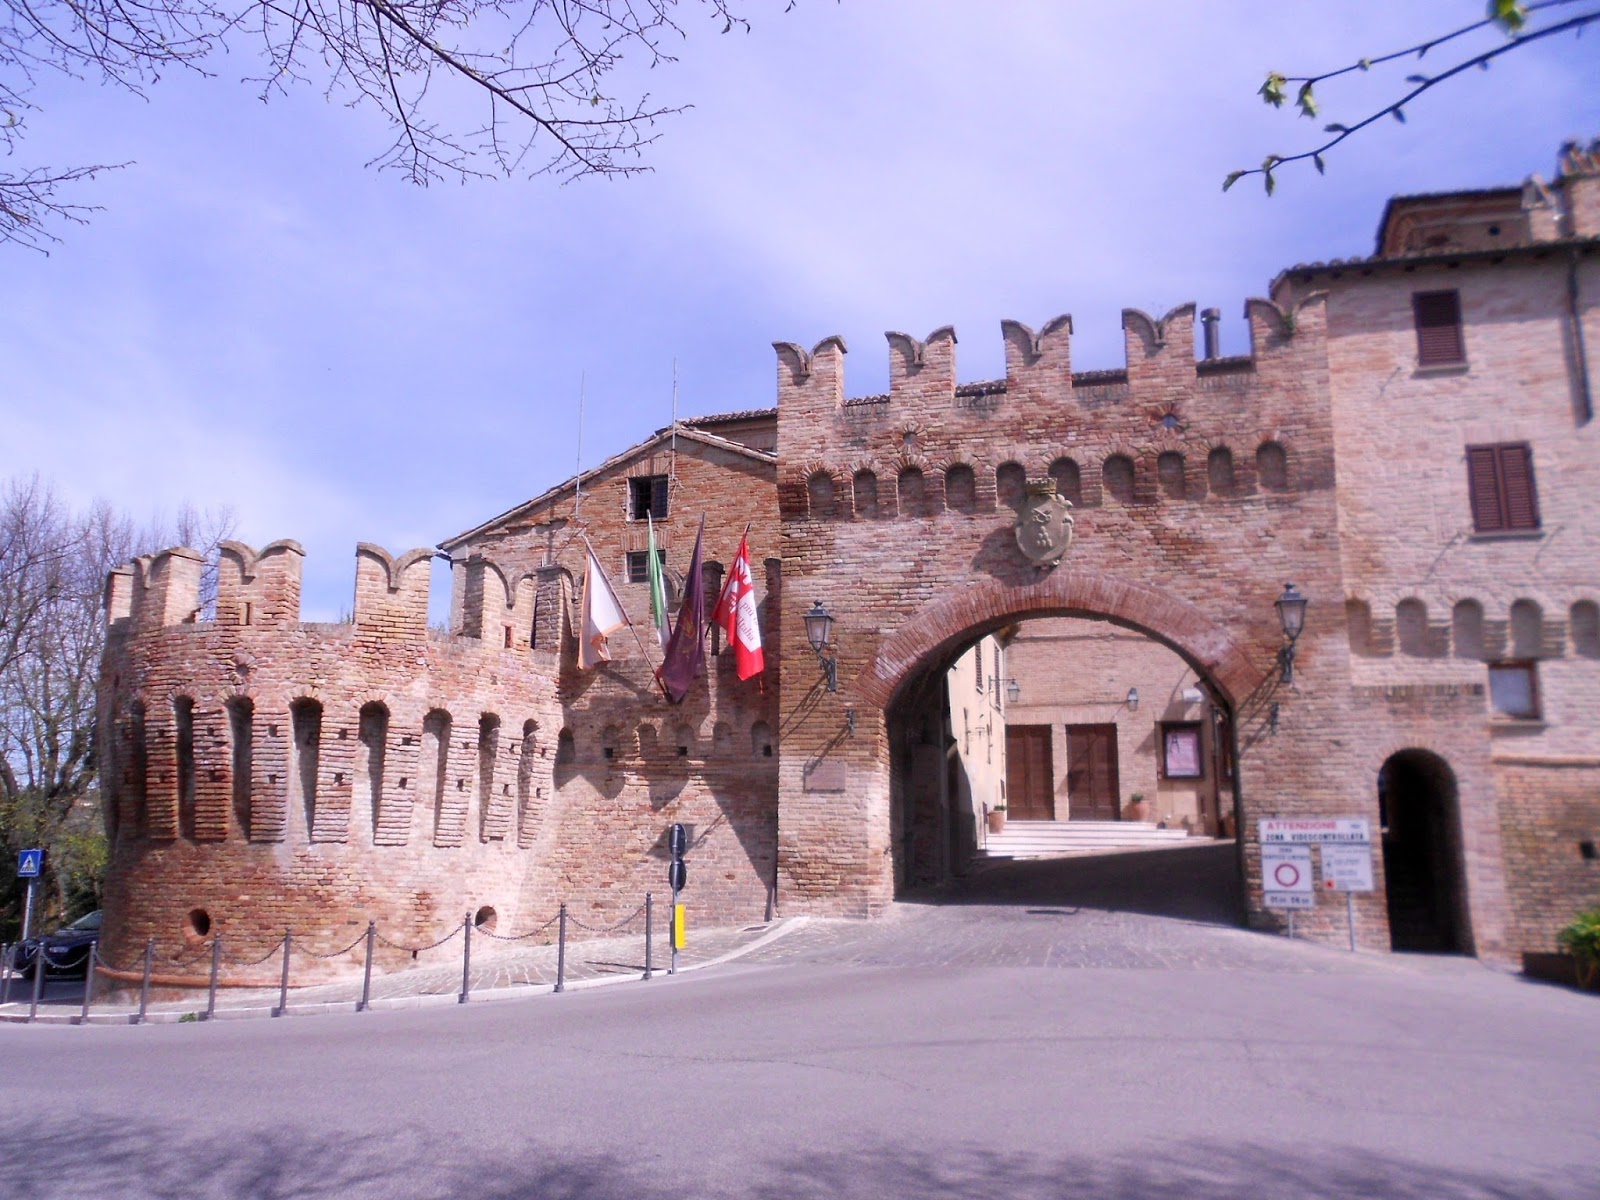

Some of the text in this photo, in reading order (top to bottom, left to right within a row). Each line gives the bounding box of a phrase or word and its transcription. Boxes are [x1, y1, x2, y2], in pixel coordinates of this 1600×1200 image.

[1267, 821, 1337, 830] ATTENZIONE
[1265, 832, 1364, 841] ZONA VIDEOCONTROLLATA
